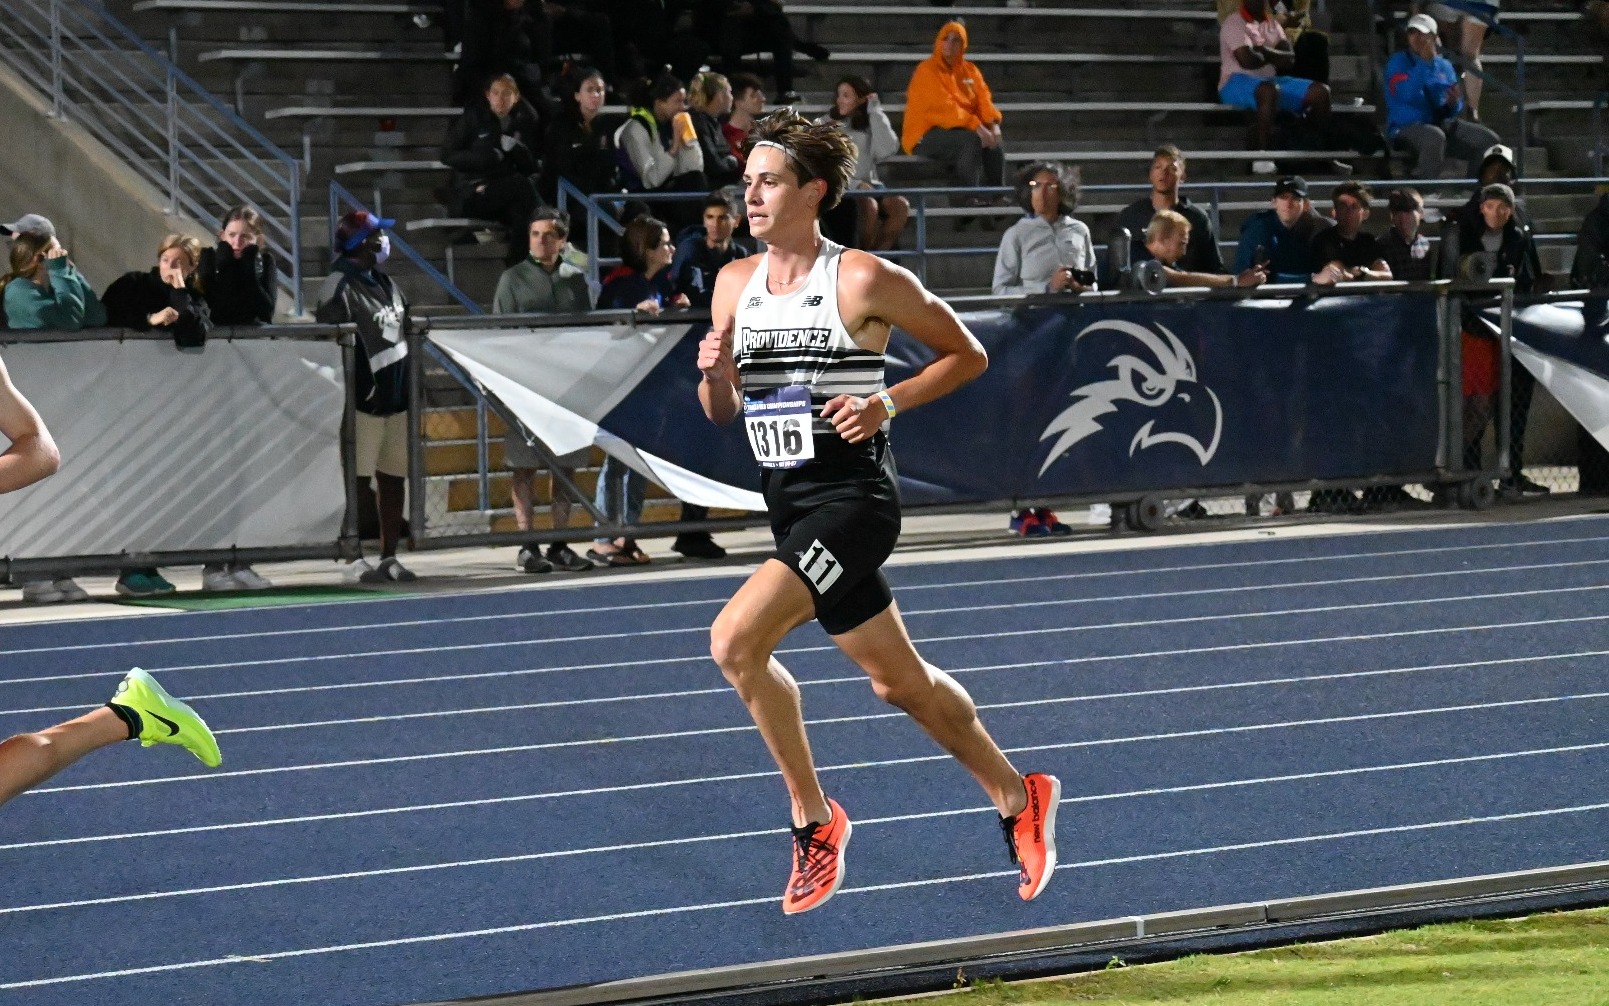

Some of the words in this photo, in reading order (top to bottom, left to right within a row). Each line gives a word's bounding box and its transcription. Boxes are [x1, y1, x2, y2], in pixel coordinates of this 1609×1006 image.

[741, 327, 832, 356] PROVIDENCE
[766, 400, 806, 410] CHAMPIONSHIPS
[750, 418, 803, 458] 1316
[803, 545, 837, 587] 11
[1029, 779, 1040, 822] balance
[1033, 823, 1041, 843] new
